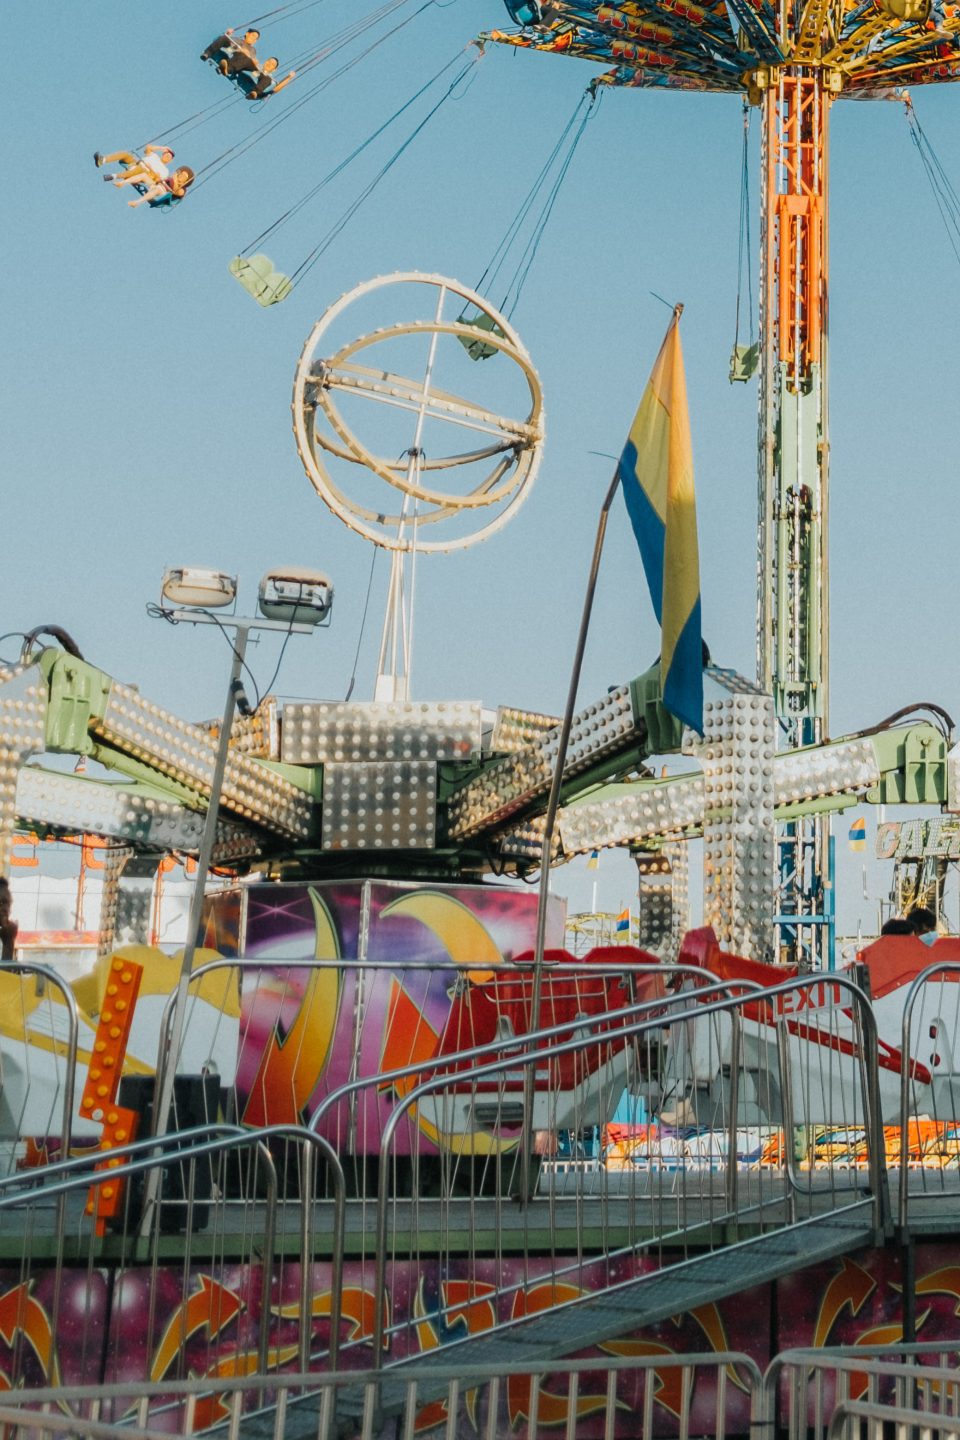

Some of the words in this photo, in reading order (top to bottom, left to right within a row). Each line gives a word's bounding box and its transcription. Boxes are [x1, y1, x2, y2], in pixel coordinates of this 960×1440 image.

[597, 6, 675, 45] FLYER
[611, 39, 677, 66] FLYER
[776, 981, 841, 1016] EXIT
